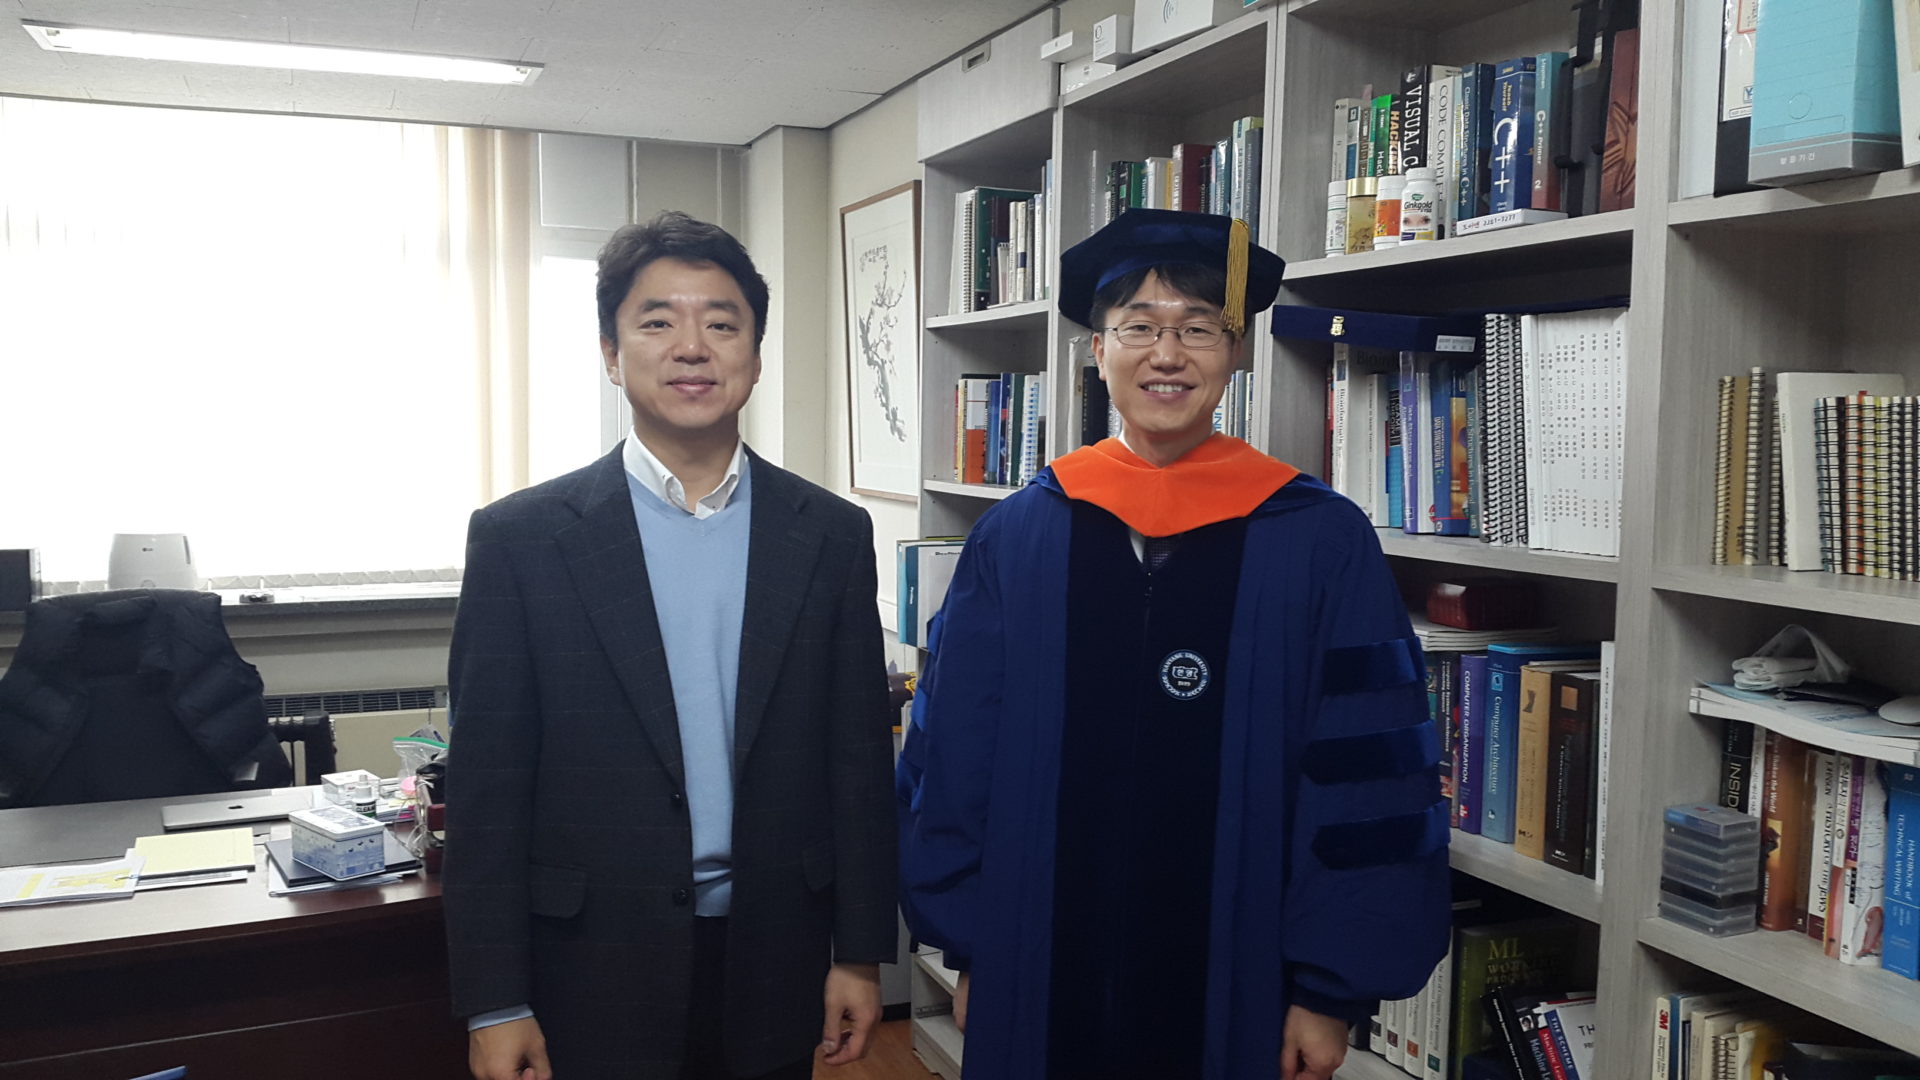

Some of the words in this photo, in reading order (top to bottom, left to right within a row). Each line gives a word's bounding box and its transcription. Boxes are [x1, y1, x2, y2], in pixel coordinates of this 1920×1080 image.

[1403, 84, 1424, 151] VISUAL
[1437, 83, 1450, 126] CODE
[1536, 109, 1547, 135] C++
[1388, 110, 1401, 175] HACKING
[1493, 117, 1517, 194] C++
[1535, 136, 1545, 165] Primer
[1459, 177, 1471, 206] C++
[1533, 179, 1542, 190] 2
[1403, 200, 1434, 211] Ginkgold
[1462, 670, 1471, 717] COMPUTER
[1491, 696, 1503, 740] Computer
[1461, 718, 1470, 783] ORGANIZATION
[1490, 741, 1502, 795] Architecture
[1768, 791, 1777, 813] World
[1770, 779, 1778, 791] the
[1822, 810, 1833, 853] HISTORY
[1894, 814, 1905, 857] TECHNICAL
[1893, 859, 1903, 897] WRITING
[1905, 838, 1916, 887] HANDBOOK
[1817, 885, 1827, 913] JEWS
[1904, 891, 1913, 900] of
[1488, 937, 1524, 960] ML
[1658, 1009, 1669, 1031] 3M
[1529, 1038, 1547, 1072] Machine
[1542, 1033, 1557, 1064] Machine
[1550, 1016, 1562, 1033] THE
[1556, 1036, 1574, 1070] SCHEME
